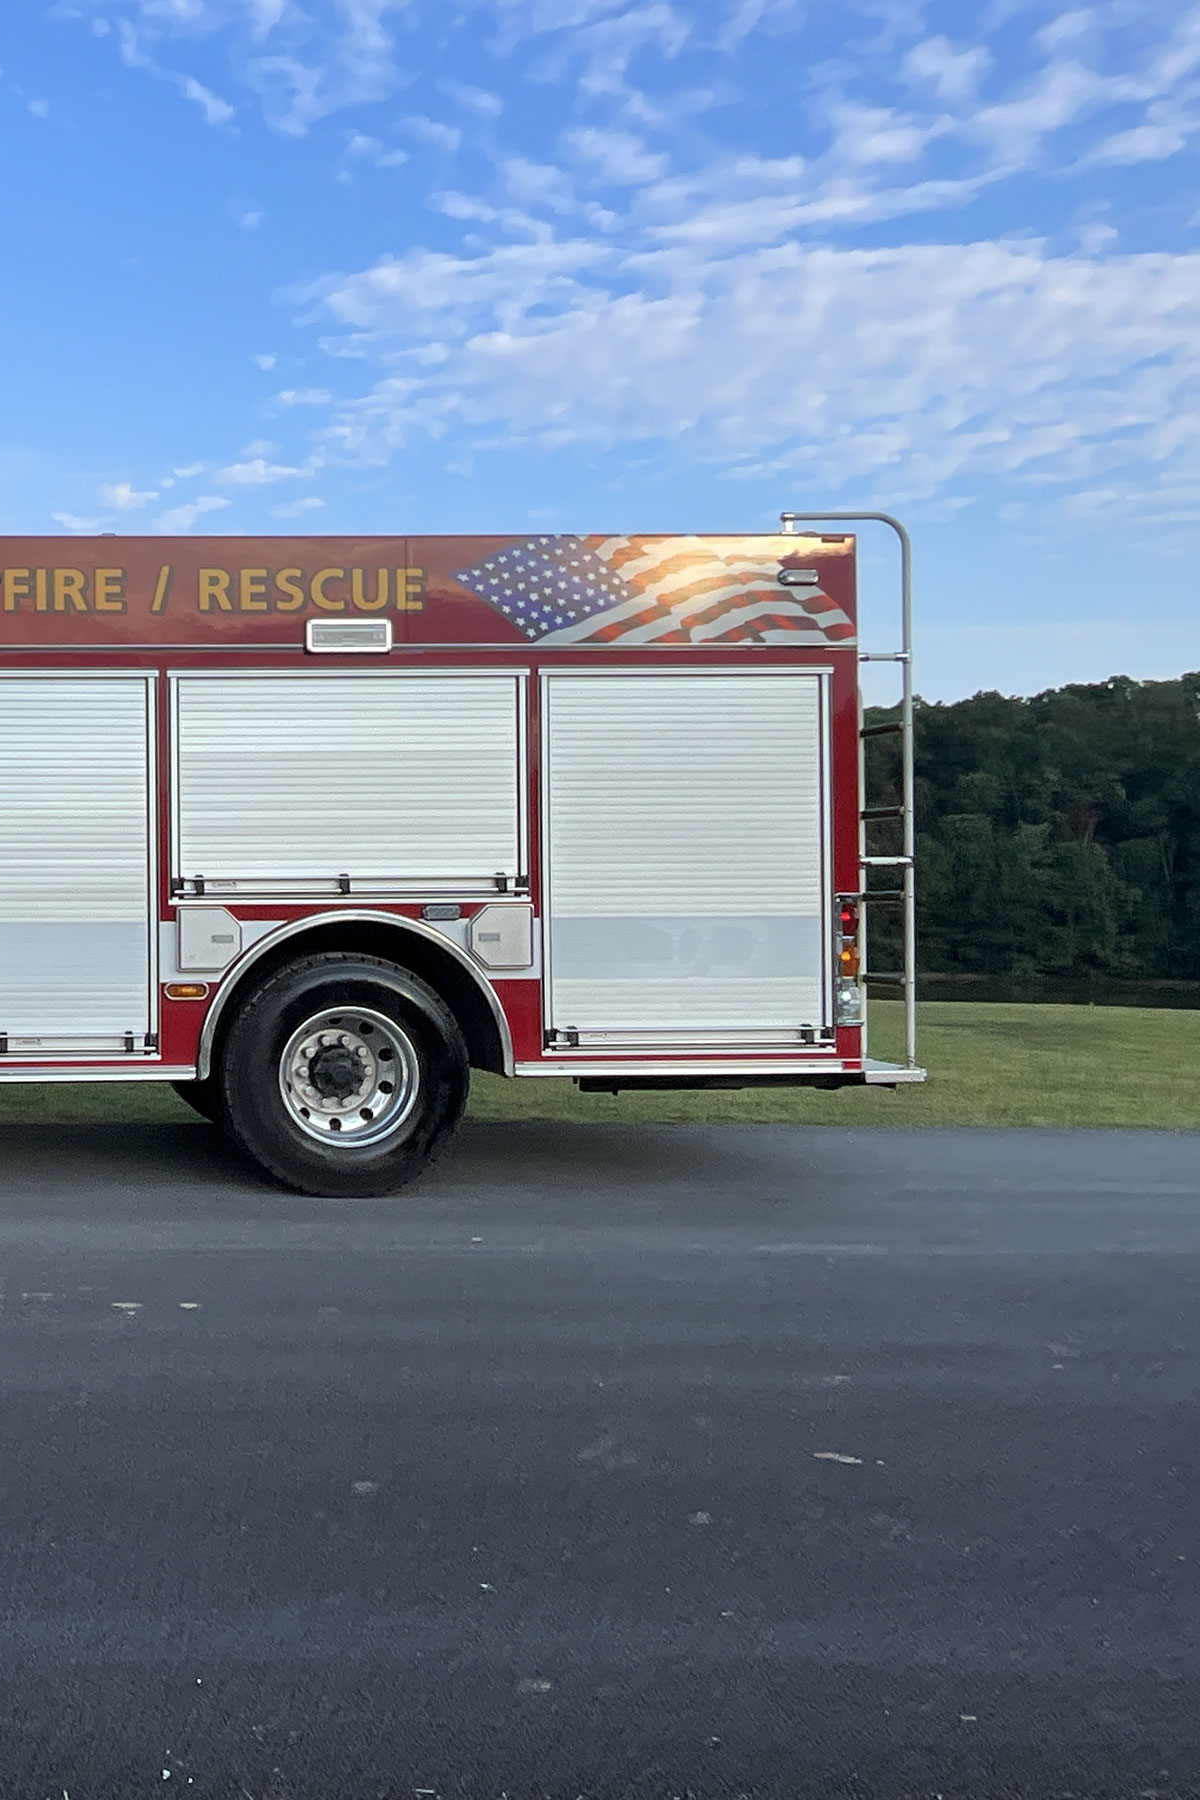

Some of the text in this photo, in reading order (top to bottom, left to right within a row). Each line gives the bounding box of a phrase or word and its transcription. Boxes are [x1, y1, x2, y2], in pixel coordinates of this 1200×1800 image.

[3, 564, 424, 613] FIRE / RESCUE
